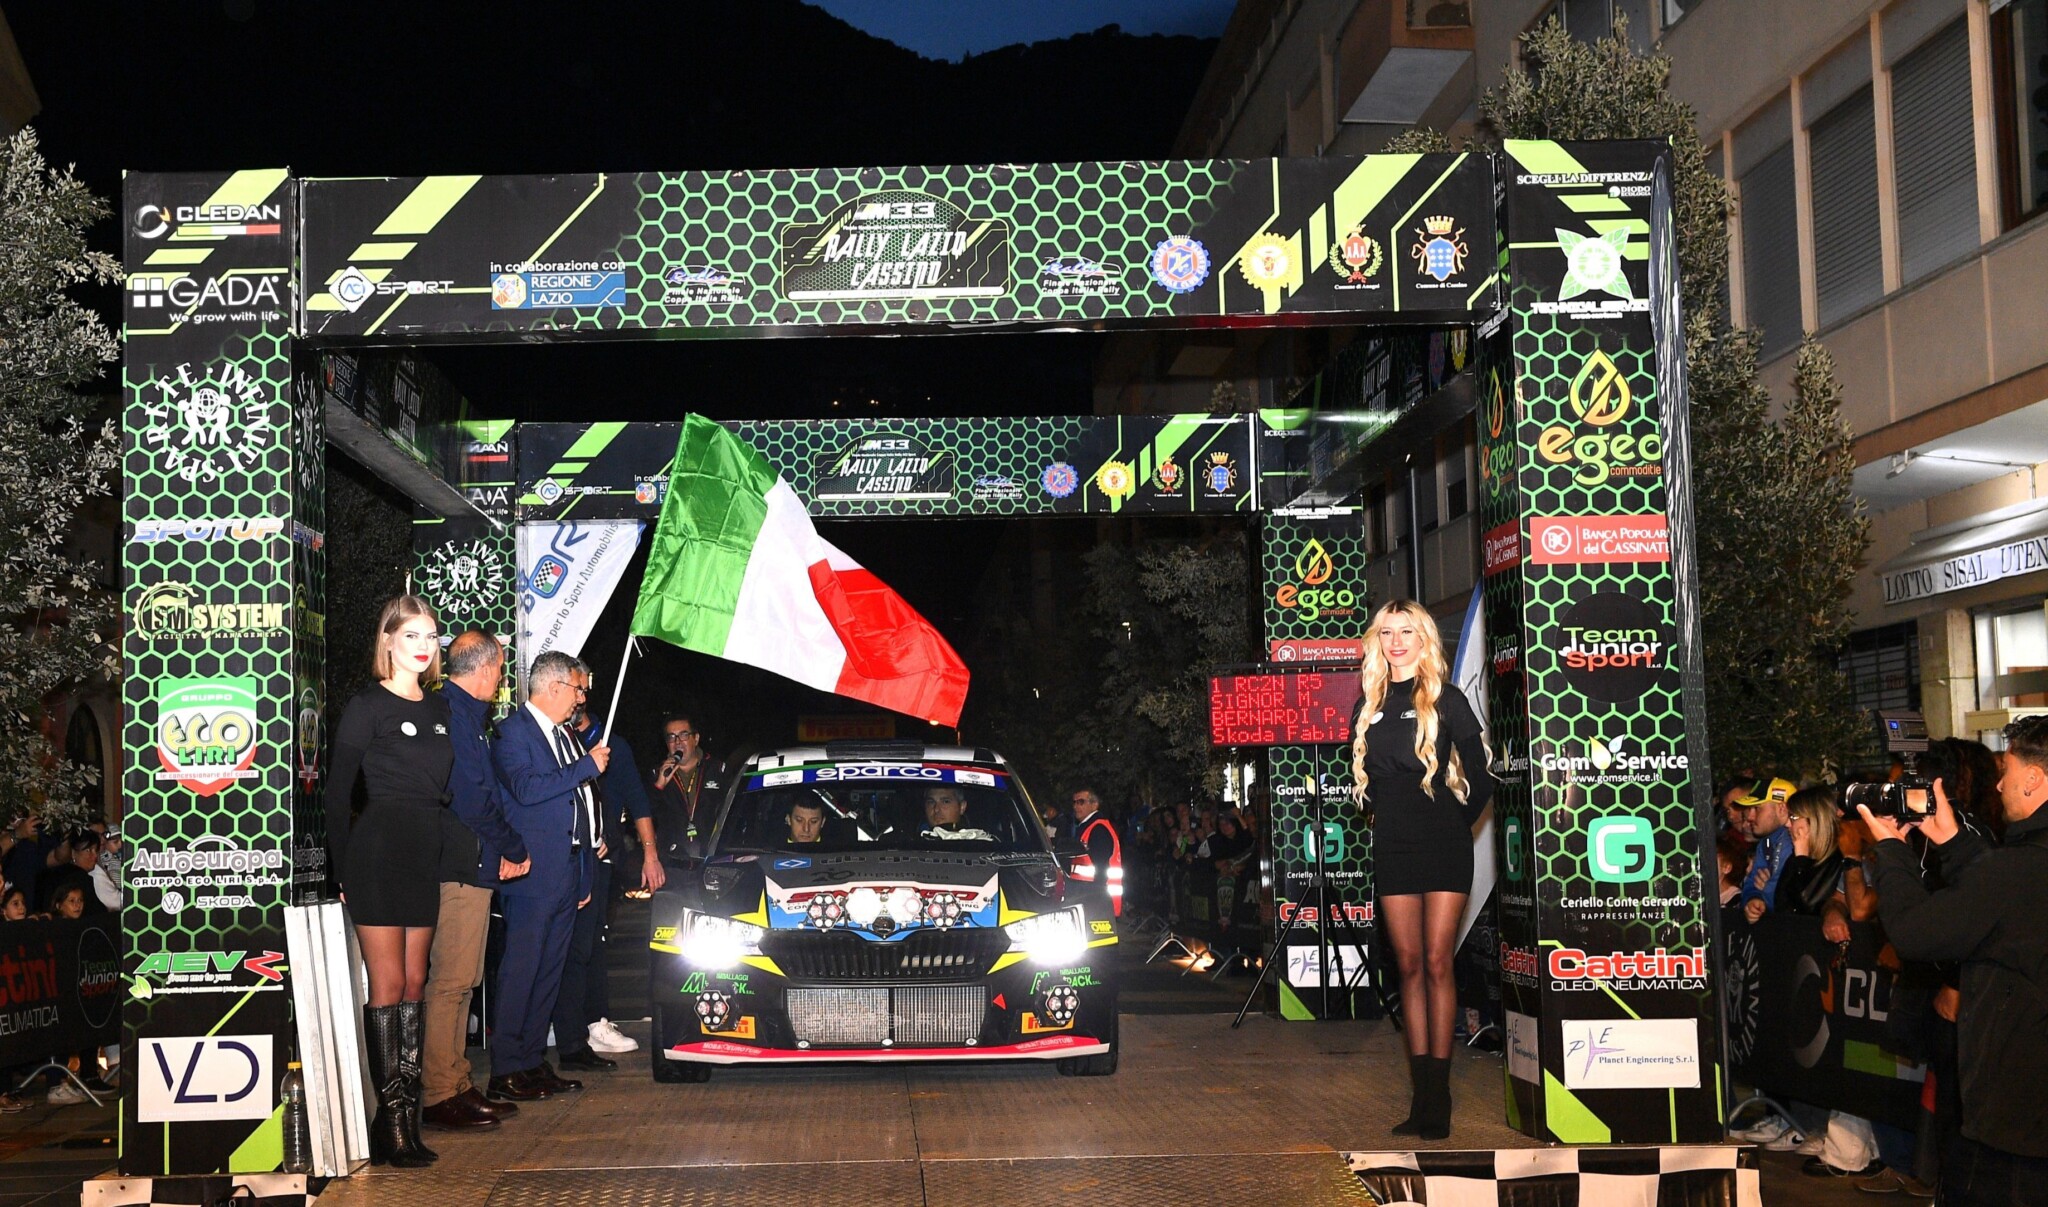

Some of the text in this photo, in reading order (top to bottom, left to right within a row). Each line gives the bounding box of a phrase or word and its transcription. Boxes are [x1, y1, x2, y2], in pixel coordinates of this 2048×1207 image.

[1516, 174, 1560, 185] SCEGLI
[1562, 174, 1580, 184] LA
[176, 204, 281, 222] CLEDAN
[824, 231, 968, 263] RALLY LAZIO
[490, 260, 626, 272] in collaborazione con
[531, 275, 592, 288] REGIONE
[850, 261, 942, 290] CASSINO
[168, 276, 279, 307] GADA
[376, 281, 454, 296] SPORT
[531, 292, 574, 305] LAZIO
[169, 311, 280, 324] We grow with life
[1538, 426, 1662, 486] egeo
[840, 458, 882, 477] RALLY
[1610, 465, 1662, 476] commoditie
[564, 486, 612, 495] SPORT
[856, 476, 913, 494] CASSINO
[133, 518, 284, 542] SPOTUP
[1582, 526, 1670, 540] BANCA POPOLAR
[1584, 543, 1599, 555] del
[1885, 568, 1932, 601] LOTTO
[1944, 554, 1988, 589] SISAL
[1276, 584, 1354, 621] egeo
[193, 602, 283, 630] SYSTEM
[1319, 608, 1354, 616] commodities
[214, 631, 283, 639] MANAGEMENT
[550, 617, 564, 638] per
[1562, 626, 1658, 643] Team
[1494, 634, 1517, 649] Team
[1558, 636, 1662, 657] Junior
[1302, 647, 1356, 655] BANCA POPOLARE
[1494, 644, 1518, 664] Junior
[1566, 651, 1655, 672] Sport
[1212, 674, 1324, 693] 1 RC2N R5
[181, 694, 233, 702] GRUPPO
[1212, 692, 1319, 710] SIGNOR M.
[1212, 708, 1346, 727] BERNARDI P.
[161, 711, 253, 754] ECO
[1213, 727, 1274, 744] Skoda
[178, 746, 238, 766] LIRI
[1540, 752, 1689, 771] Gom Service
[816, 767, 942, 780] sparco
[1570, 773, 1662, 784] www.gomservice.it
[1276, 783, 1352, 796] Gom Servi
[132, 847, 283, 874] Autoeuropa
[132, 878, 182, 887] GRUPPO
[187, 877, 212, 886] ECO
[216, 876, 242, 885] LIRI
[1336, 870, 1363, 878] Gerardo
[1560, 896, 1686, 908] Ceriello Conte Gerardo
[1280, 902, 1374, 922] Catini
[1581, 911, 1666, 920] RAPPRESENTANZE
[654, 929, 677, 939] OMP
[1090, 923, 1112, 932] OMP
[82, 959, 116, 974] Team
[1500, 940, 1538, 978] Cattini
[1548, 947, 1706, 980] Cattini
[80, 971, 119, 987] Junior
[1551, 978, 1705, 992] OLEOPNEUMATICA
[1599, 1056, 1695, 1066] Planet Engineering S.r.l.
